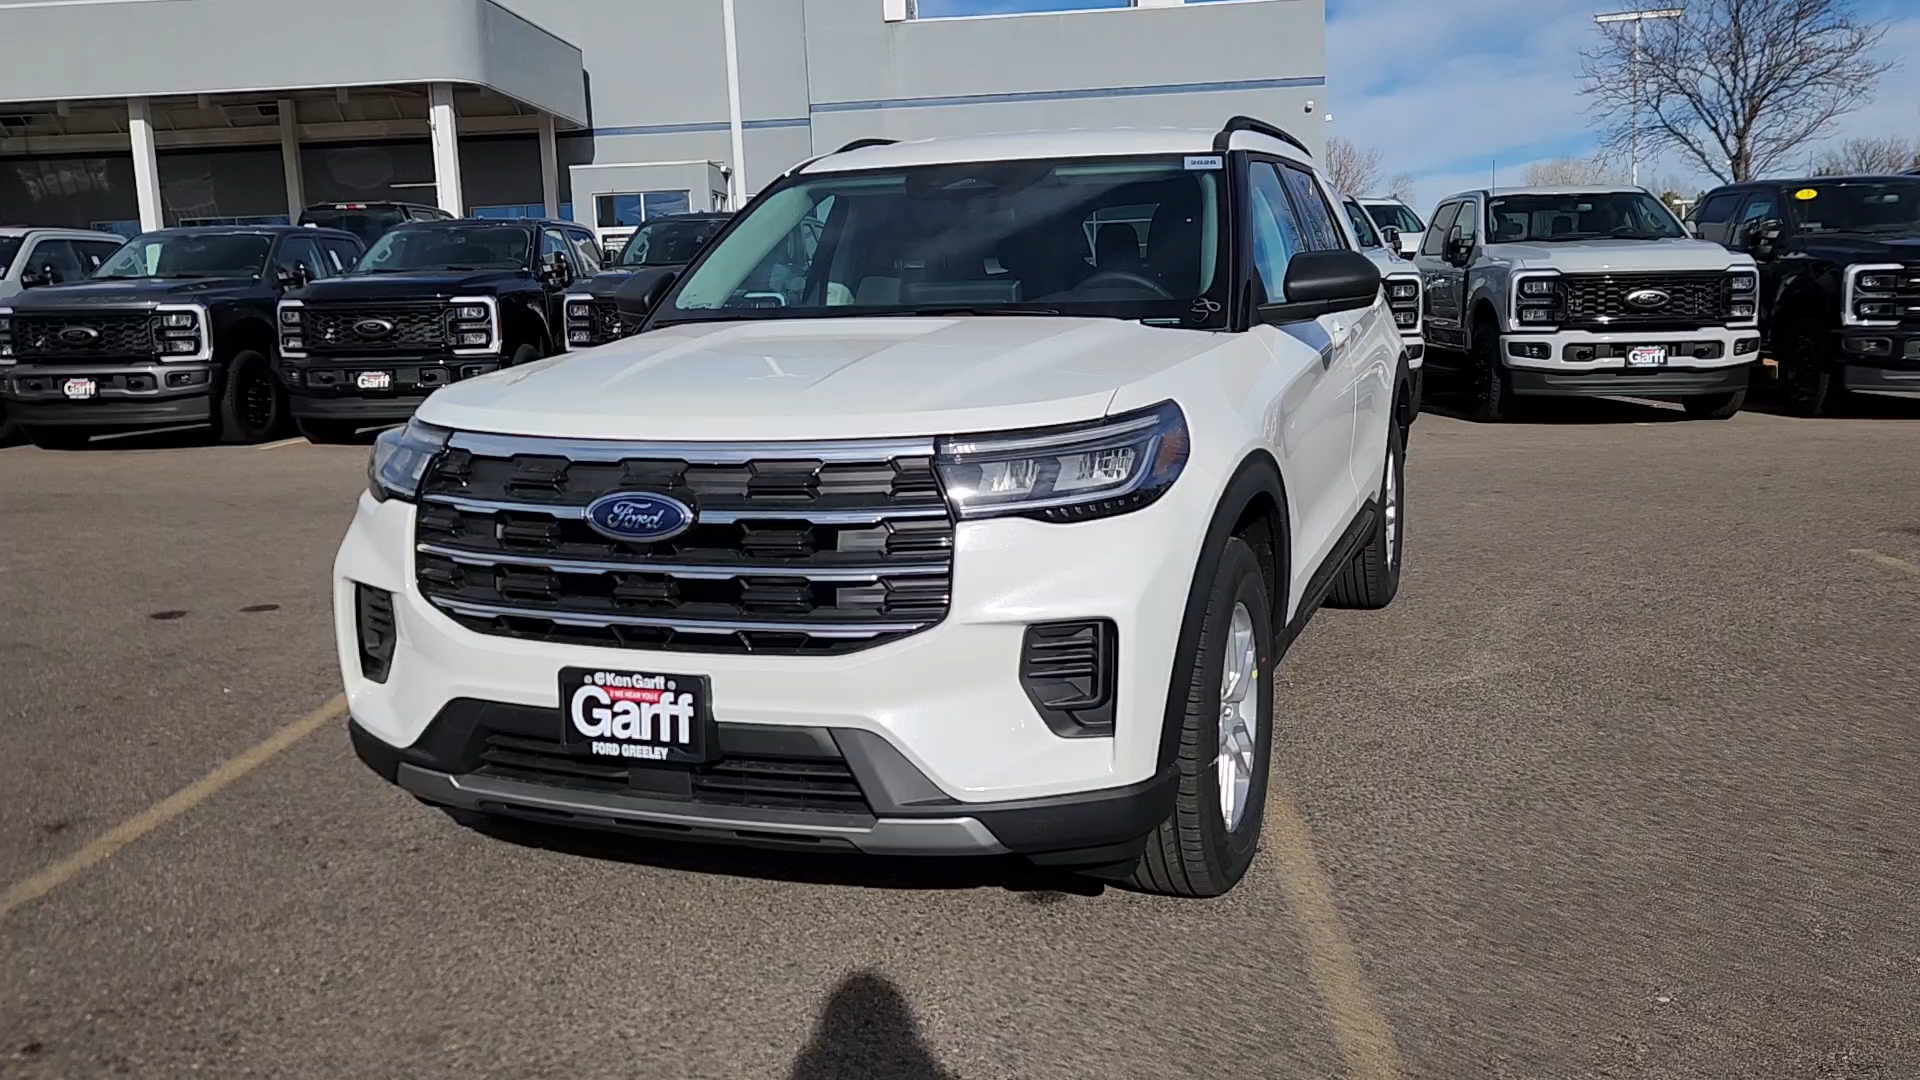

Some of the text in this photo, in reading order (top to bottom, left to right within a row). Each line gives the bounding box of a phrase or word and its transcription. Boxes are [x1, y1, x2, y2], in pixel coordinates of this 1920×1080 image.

[1628, 349, 1666, 363] Garff
[357, 374, 391, 389] Garff
[607, 500, 665, 529] Ford
[605, 672, 666, 690] Ken Garff
[571, 685, 694, 744] Garff
[592, 741, 669, 761] FORD GREELEY
